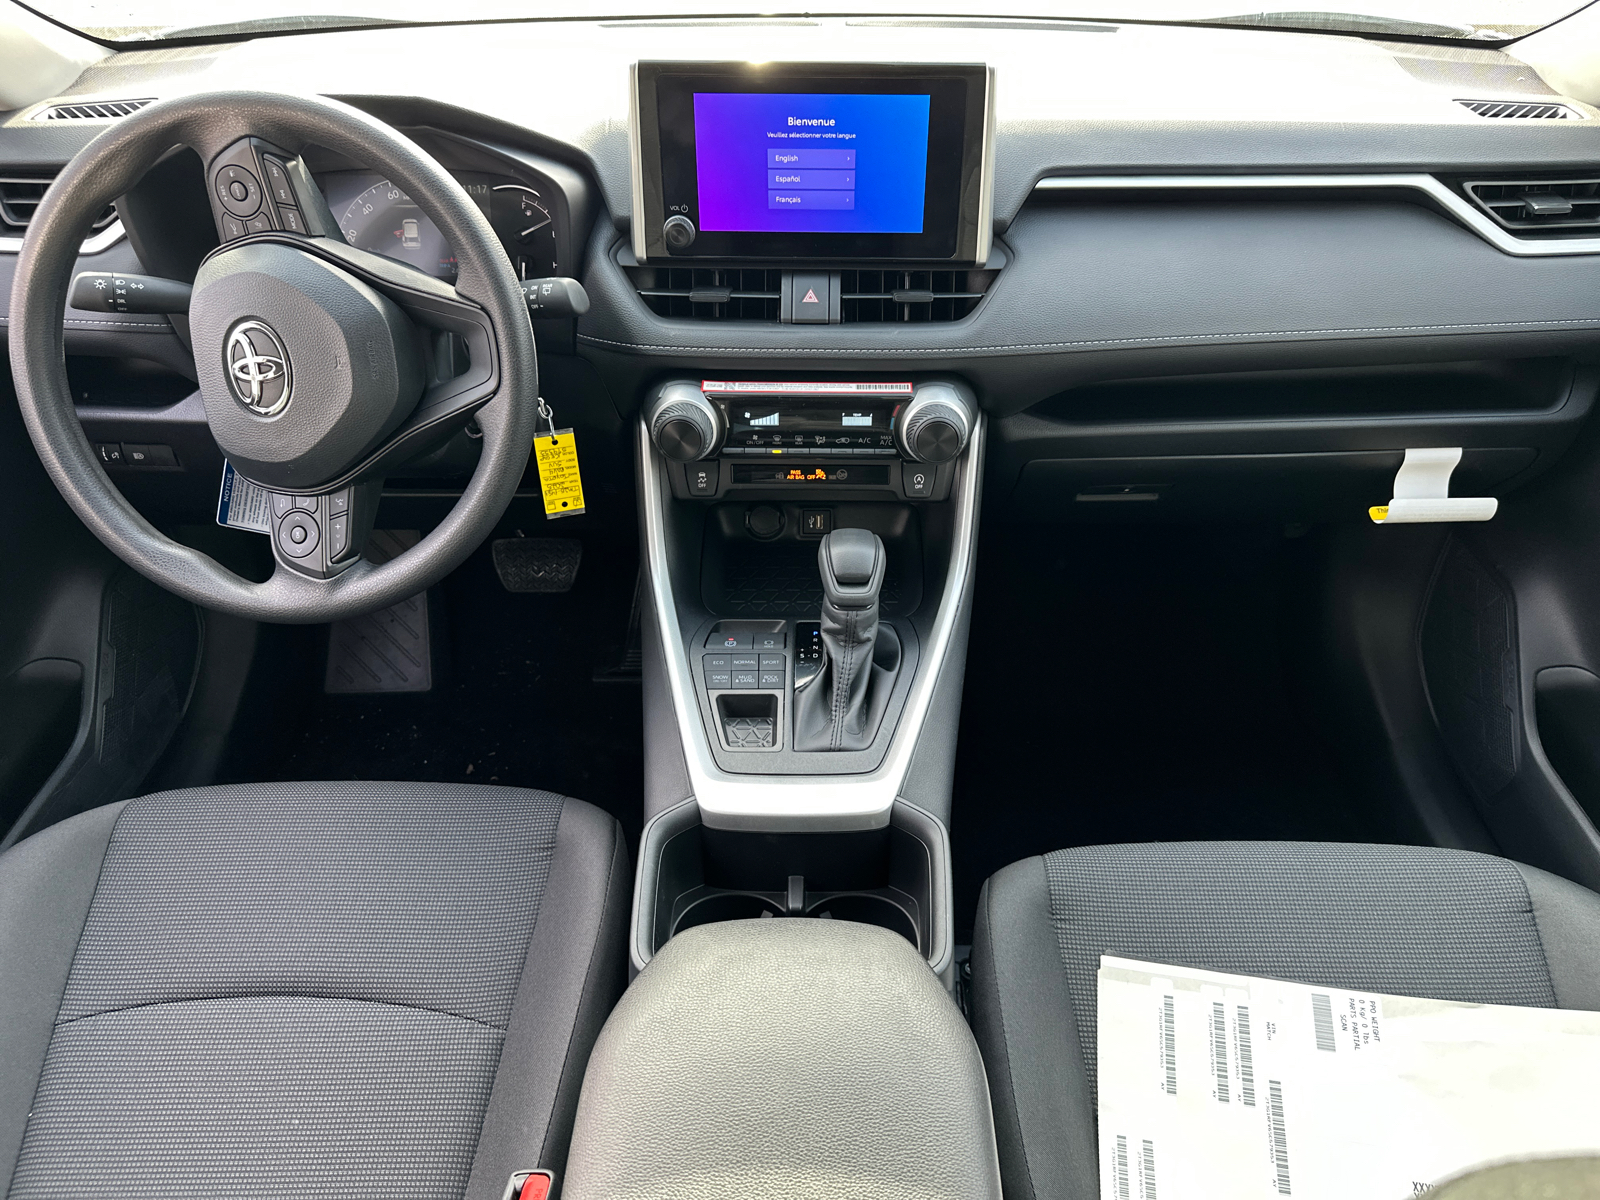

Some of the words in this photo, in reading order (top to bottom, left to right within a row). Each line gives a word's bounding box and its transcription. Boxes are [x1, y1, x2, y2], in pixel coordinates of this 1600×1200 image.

[787, 116, 836, 126] Bienvenue
[776, 155, 798, 163] English
[388, 190, 400, 200] 60
[362, 204, 374, 215] 40
[288, 213, 297, 230] MODE
[347, 229, 358, 243] 20
[224, 472, 232, 502] NOTICE
[1349, 998, 1357, 1018] PARTS
[1340, 1014, 1348, 1031] SCAN
[1371, 1016, 1380, 1042] WEIGHT
[1352, 1022, 1360, 1050] PARTIAL
[1272, 1179, 1277, 1188] AY
